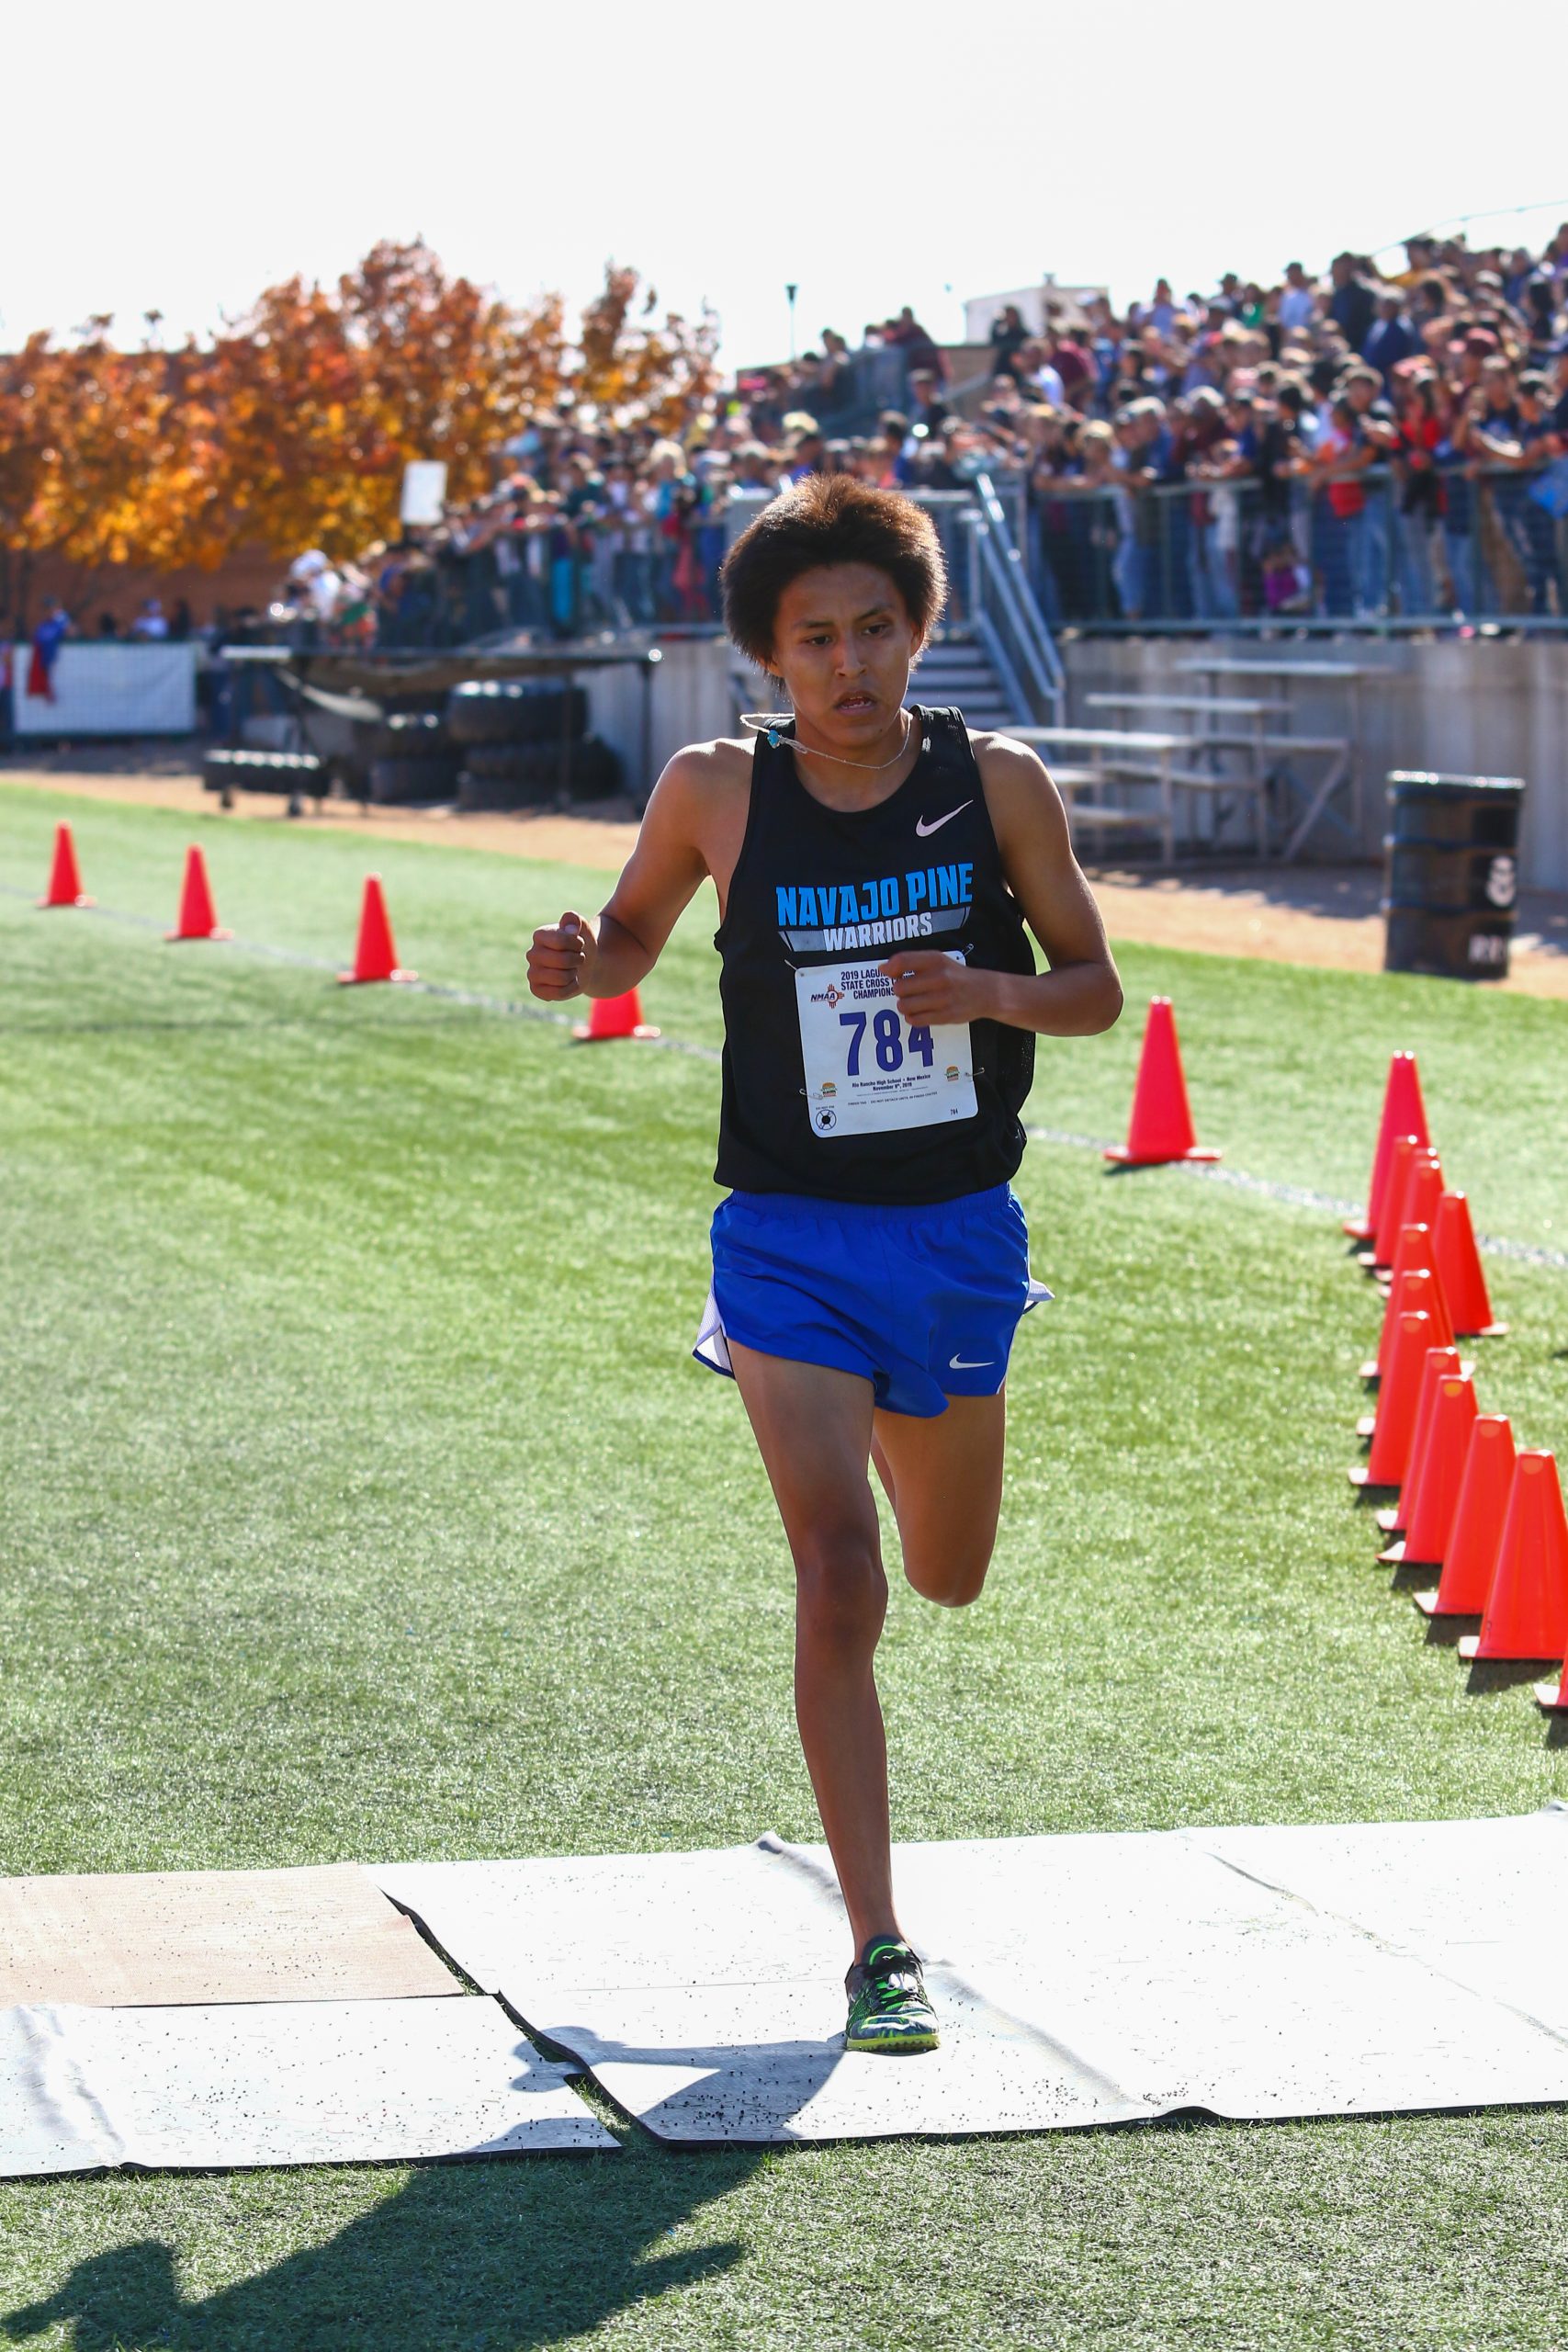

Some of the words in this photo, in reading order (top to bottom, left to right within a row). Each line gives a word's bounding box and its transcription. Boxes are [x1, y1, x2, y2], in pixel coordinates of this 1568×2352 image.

[776, 877, 900, 927] NAVAJO
[906, 863, 974, 911] PINE
[823, 911, 932, 952] WARRIORS
[840, 970, 859, 980] 2019
[840, 979, 864, 991] STATE
[865, 978, 890, 989] CROSS
[810, 992, 835, 1001] NMAA
[839, 1009, 934, 1076] 784
[950, 1108, 958, 1116] 784
